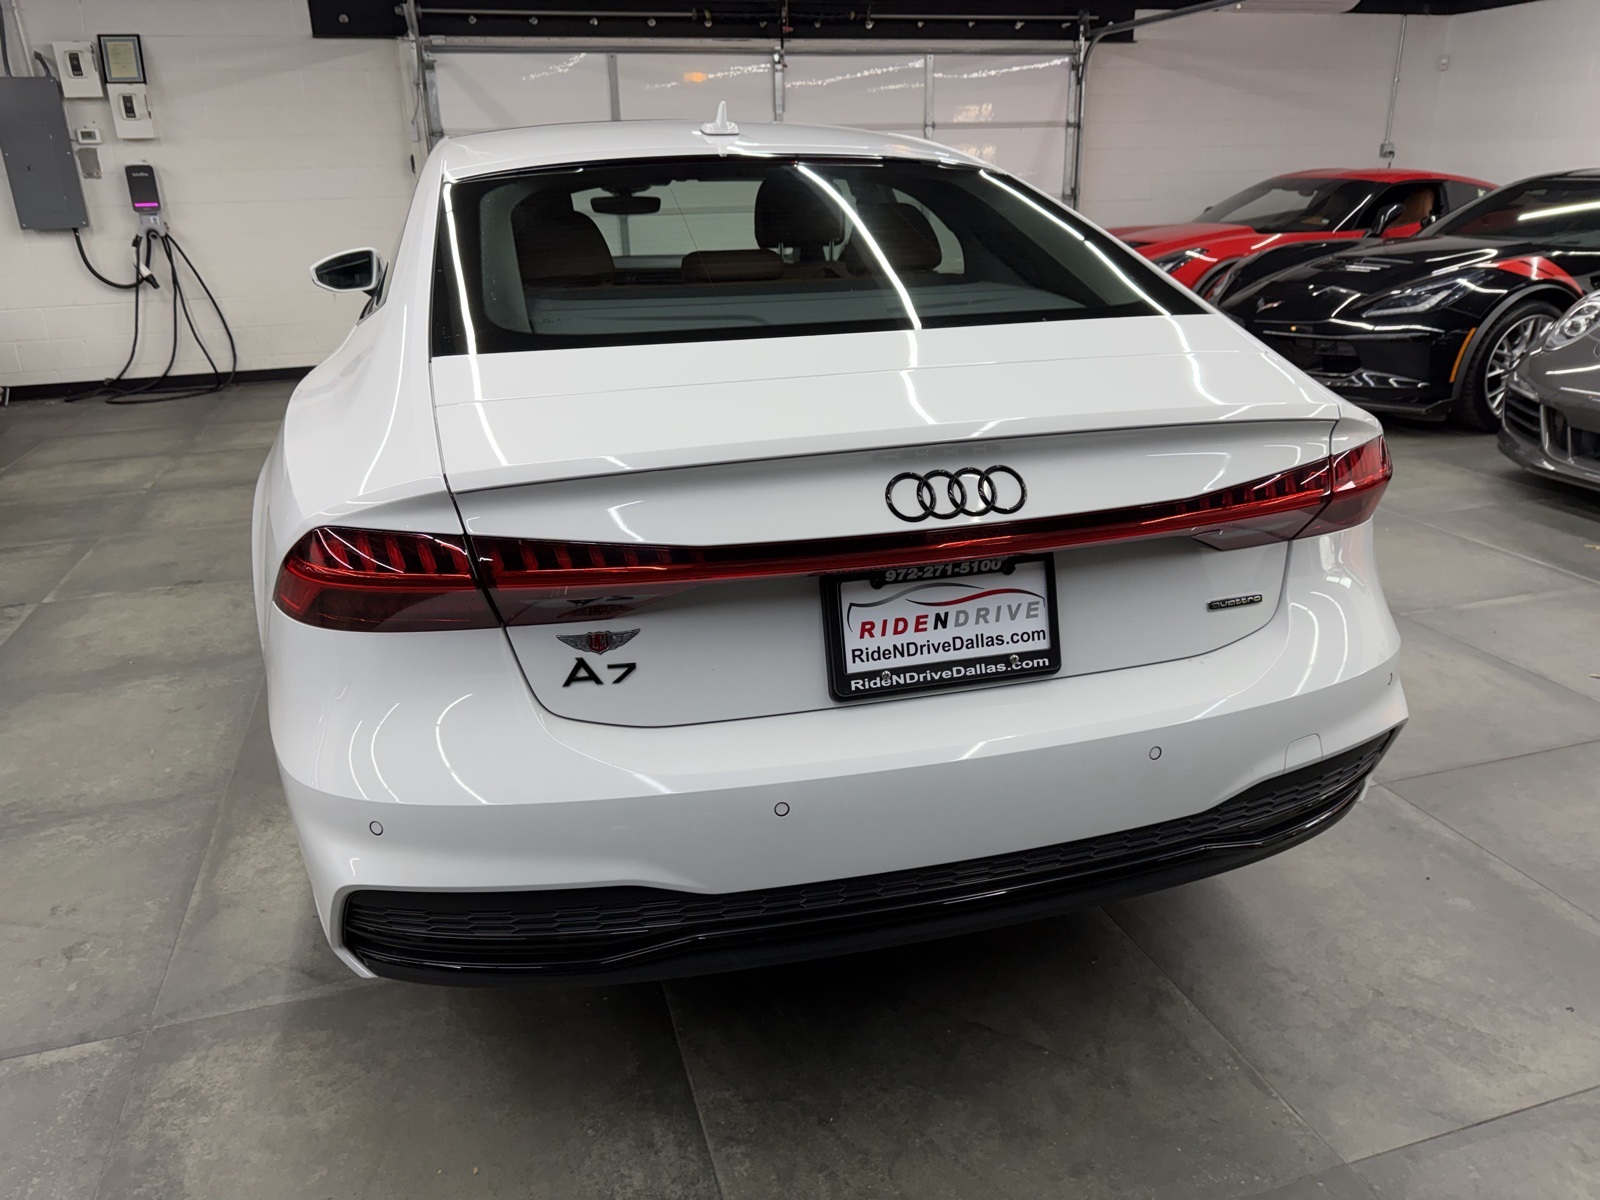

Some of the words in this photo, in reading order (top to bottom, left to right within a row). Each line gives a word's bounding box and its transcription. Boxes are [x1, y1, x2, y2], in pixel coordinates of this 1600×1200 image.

[885, 559, 1002, 583] 972-271-5100
[851, 628, 1047, 665] RideNDriveDallas.com
[562, 656, 637, 688] A7
[850, 657, 1050, 692] RideNDriveDallas.com
